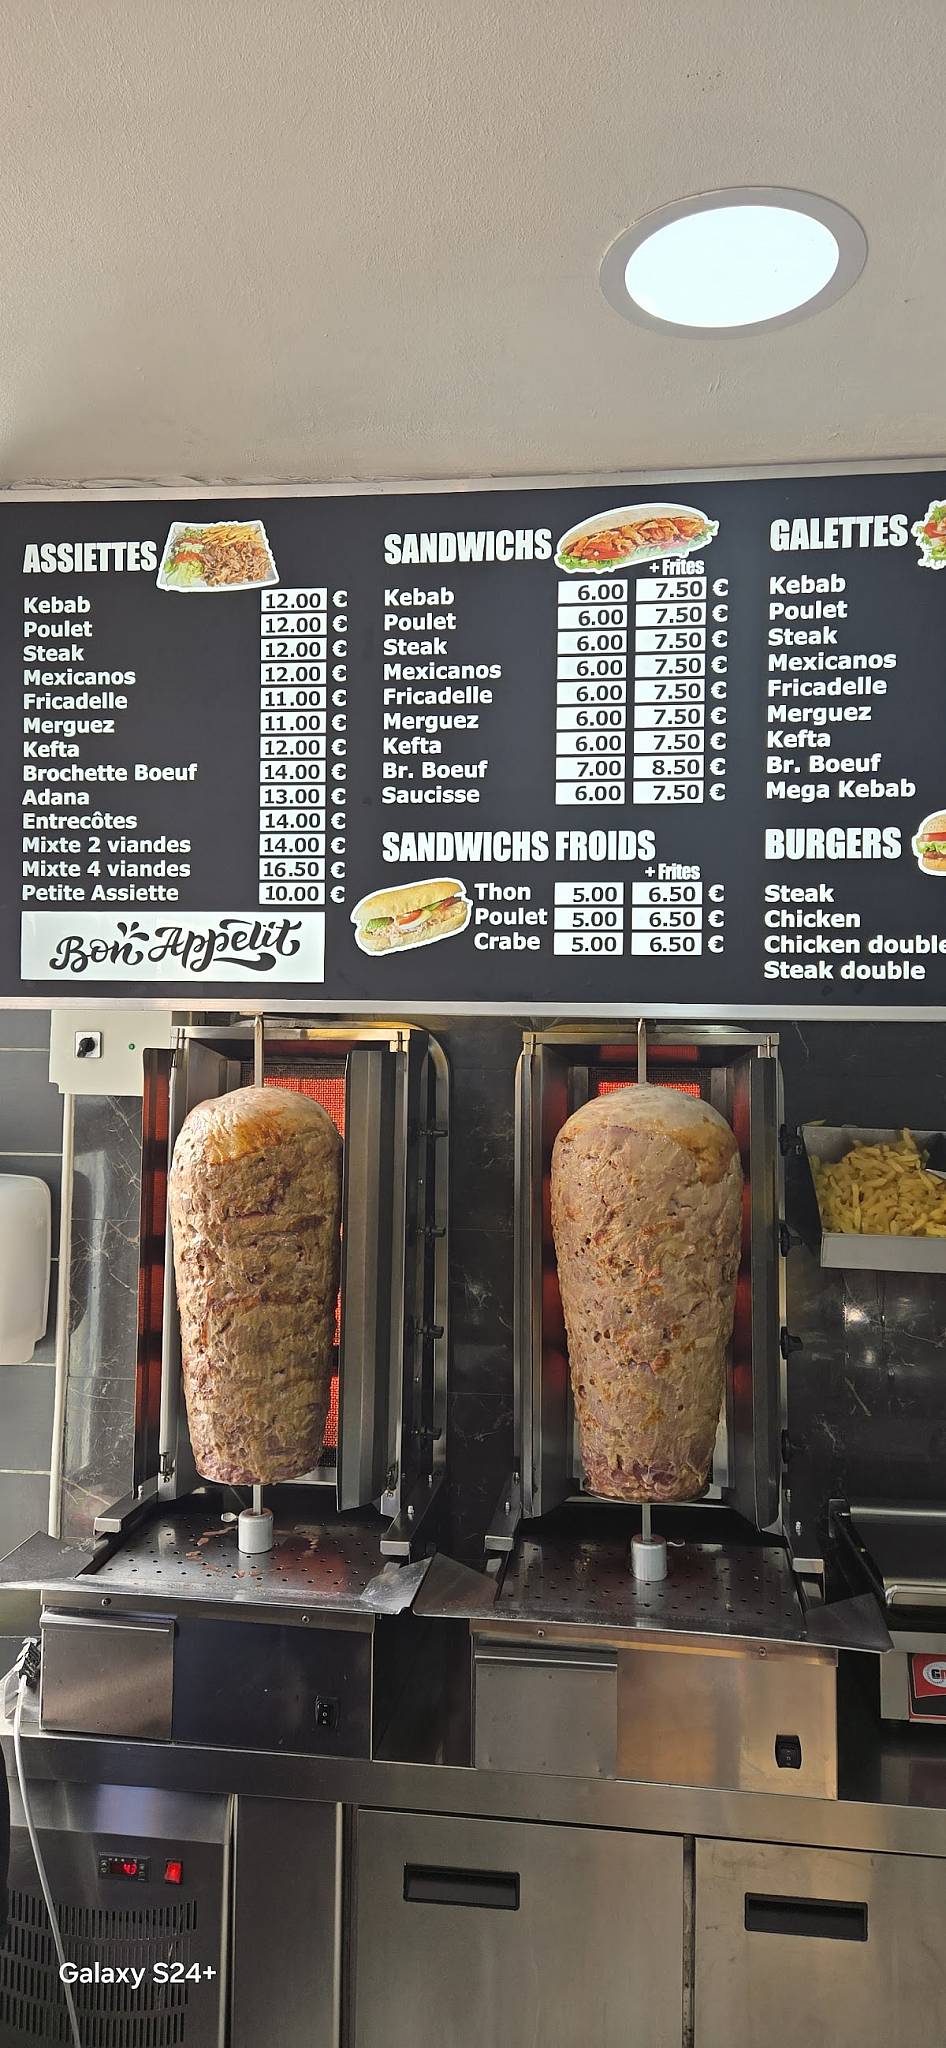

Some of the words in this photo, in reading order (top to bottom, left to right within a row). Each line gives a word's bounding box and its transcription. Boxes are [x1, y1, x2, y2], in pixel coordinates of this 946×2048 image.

[769, 513, 909, 552] GALETTES
[22, 540, 157, 574] ASSIETTES
[384, 528, 553, 565] SANDWICHS
[648, 562, 660, 573] +
[662, 558, 705, 576] Frites
[384, 586, 455, 607] Kebab
[577, 583, 624, 601] 6.00
[655, 580, 703, 599] 7.50
[711, 577, 729, 597] €
[769, 573, 846, 595] Kebab
[23, 595, 91, 614] Kebab
[265, 592, 321, 609] 12.00
[332, 590, 348, 608] €
[769, 599, 848, 621] Poulet
[23, 619, 93, 638] Poulet
[265, 616, 321, 634] 12.00
[332, 614, 348, 633] €
[384, 612, 457, 631] Poulet
[578, 608, 624, 627] 6.00
[655, 606, 703, 624] 7.50
[711, 603, 729, 623] €
[383, 636, 448, 656] Steak
[576, 634, 623, 652] 6.00
[654, 632, 702, 650] 7.50
[711, 629, 728, 648] €
[767, 625, 838, 647] Steak
[23, 643, 85, 662] Steak
[265, 641, 321, 658] 12.00
[332, 639, 348, 658] €
[768, 651, 897, 672] Mexicanos
[23, 668, 137, 686] Mexicanos
[265, 666, 321, 683] 12.00
[331, 664, 347, 682] €
[383, 661, 502, 681] Mexicanos
[576, 659, 623, 677] 6.00
[654, 657, 702, 675] 7.50
[710, 655, 728, 674] €
[383, 685, 493, 706] Fricadelle
[576, 684, 623, 702] 6.00
[654, 682, 701, 700] 7.50
[710, 680, 727, 700] €
[767, 675, 888, 698] Fricadelle
[23, 691, 128, 710] Fricadelle
[265, 690, 321, 707] 11.00
[331, 688, 347, 707] €
[23, 717, 115, 738] Merguez
[265, 715, 321, 731] 11.00
[331, 713, 347, 732] €
[383, 712, 479, 734] Merguez
[576, 710, 622, 727] 6.00
[653, 708, 701, 725] 7.50
[710, 706, 727, 725] €
[767, 704, 872, 726] Merguez
[23, 740, 80, 758] Kefta
[264, 739, 320, 756] 12.00
[331, 738, 347, 756] €
[383, 736, 442, 755] Kefta
[575, 735, 622, 752] 6.00
[653, 733, 701, 751] 7.50
[709, 731, 727, 751] €
[767, 728, 831, 749] Kefta
[23, 763, 128, 782] Brochette
[134, 762, 198, 782] Boeuf
[264, 764, 320, 780] 14.00
[330, 762, 347, 781] €
[382, 761, 414, 779] Br.
[421, 759, 489, 779] Boeuf
[576, 760, 622, 778] 7.00
[652, 759, 700, 776] 8.50
[709, 757, 726, 776] €
[766, 755, 801, 774] Br.
[809, 752, 882, 773] Boeuf
[21, 788, 90, 806] Adana
[264, 788, 320, 805] 13.00
[330, 787, 346, 805] €
[381, 785, 480, 804] Saucisse
[575, 785, 622, 802] 6.00
[653, 784, 700, 801] 7.50
[708, 782, 726, 801] €
[766, 781, 830, 803] Mega
[838, 778, 916, 798] Kebab
[22, 810, 138, 830] Entrecôtes
[265, 812, 321, 829] 14.00
[330, 812, 346, 830] €
[22, 836, 81, 854] Mixte
[87, 836, 101, 853] 2
[107, 835, 192, 854] viandes
[264, 837, 320, 853] 14.00
[330, 836, 346, 855] €
[382, 830, 550, 863] SANDWICHS
[555, 829, 656, 862] FROIDS
[764, 826, 902, 860] BURGERS
[22, 859, 81, 878] Mixte
[86, 860, 101, 877] 4
[106, 859, 191, 878] viandes
[263, 861, 320, 878] 16.50
[330, 861, 346, 879] €
[644, 866, 656, 878] +
[657, 862, 701, 881] Frites
[22, 883, 86, 901] Petite
[90, 883, 179, 902] Assiette
[265, 885, 319, 902] 10.00
[329, 885, 346, 904] €
[473, 882, 531, 901] Thon
[572, 886, 618, 903] 5.00
[648, 886, 696, 903] 6.50
[707, 883, 725, 903] €
[764, 883, 835, 903] Steak
[474, 907, 548, 926] Poulet
[572, 911, 617, 928] 5.00
[649, 911, 696, 928] 6.50
[707, 909, 725, 928] €
[764, 909, 861, 928] Chicken
[473, 931, 541, 951] Crabe
[571, 936, 617, 953] 5.00
[649, 936, 696, 953] 6.50
[707, 934, 724, 954] €
[763, 934, 861, 954] Chicken
[49, 936, 143, 973] Bon
[763, 960, 834, 980] Steak
[840, 960, 926, 980] double
